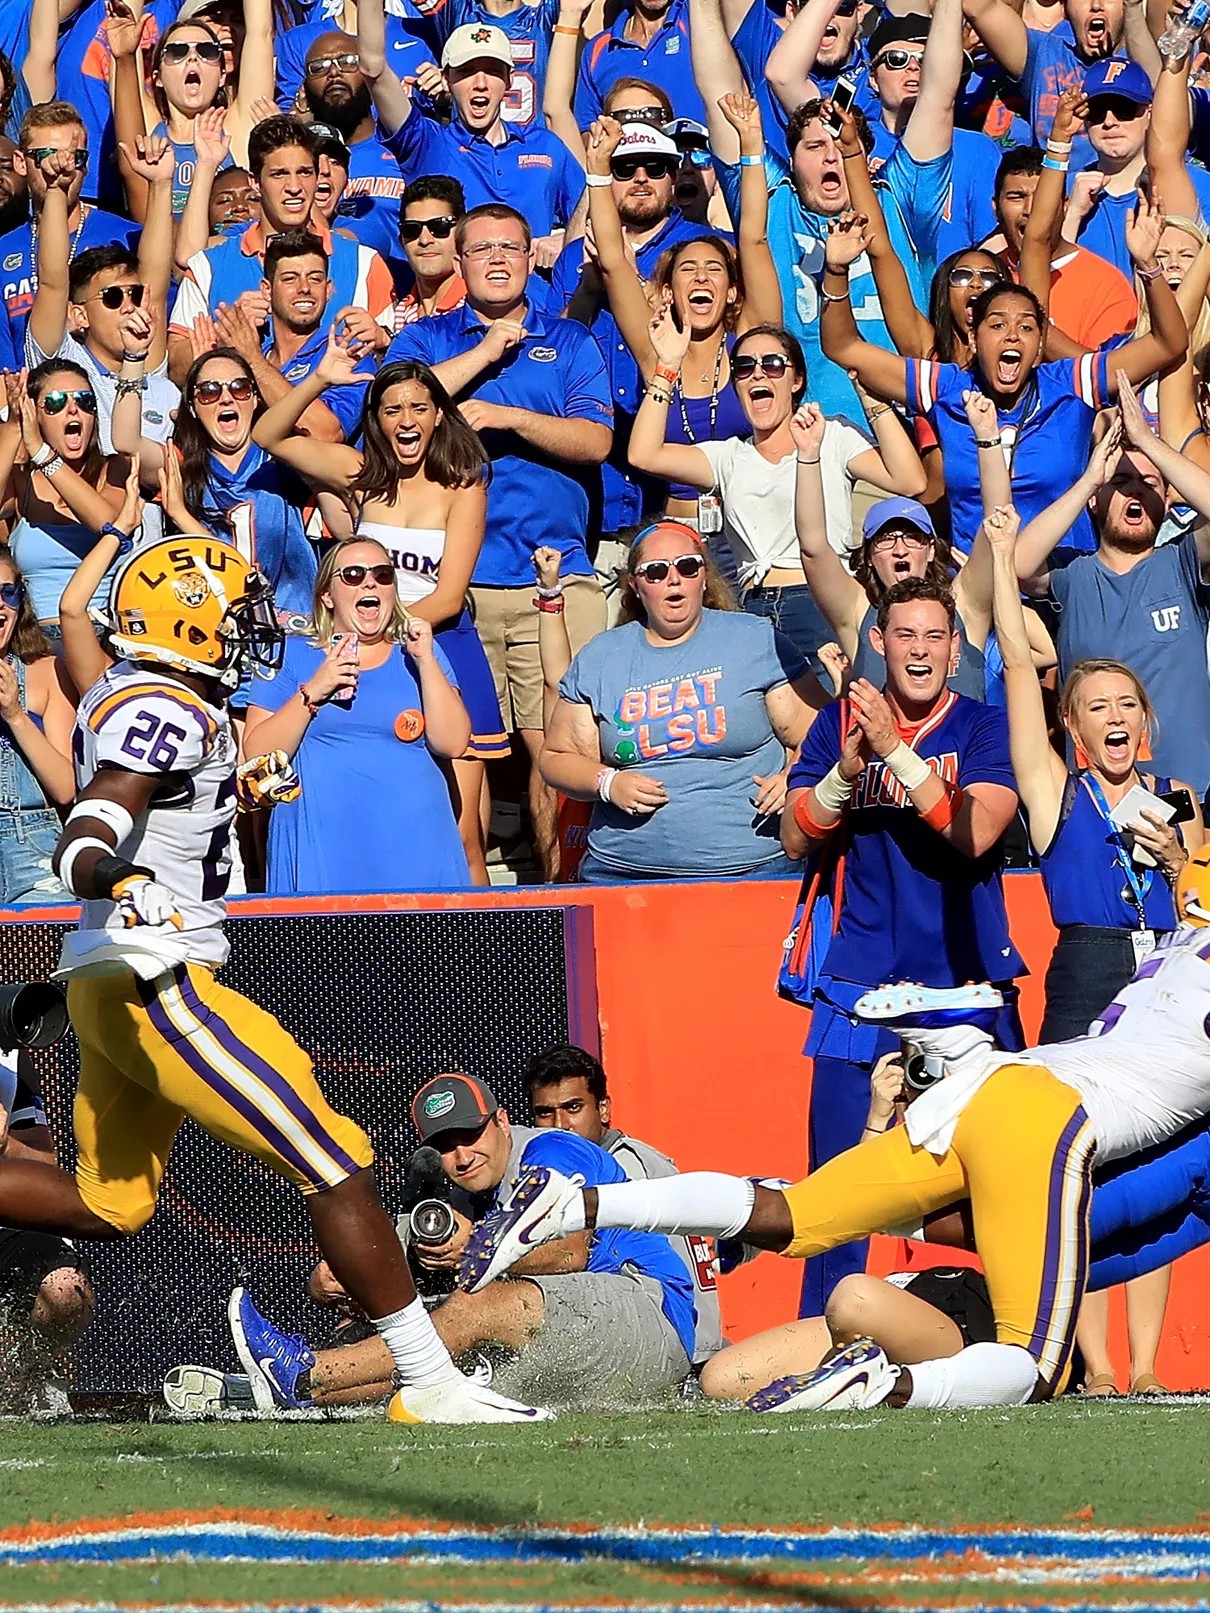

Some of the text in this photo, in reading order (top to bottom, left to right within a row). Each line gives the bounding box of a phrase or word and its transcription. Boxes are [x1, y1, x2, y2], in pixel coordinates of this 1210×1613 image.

[1101, 61, 1126, 83] F
[344, 177, 405, 200] WAMP
[139, 547, 226, 590] LSU
[391, 549, 442, 577] HOM
[1152, 606, 1181, 632] UF
[702, 665, 723, 675] ALIVE
[621, 672, 723, 723] BEAT
[120, 710, 187, 772] 26
[638, 704, 728, 758] LSU
[851, 753, 958, 809] FLOA
